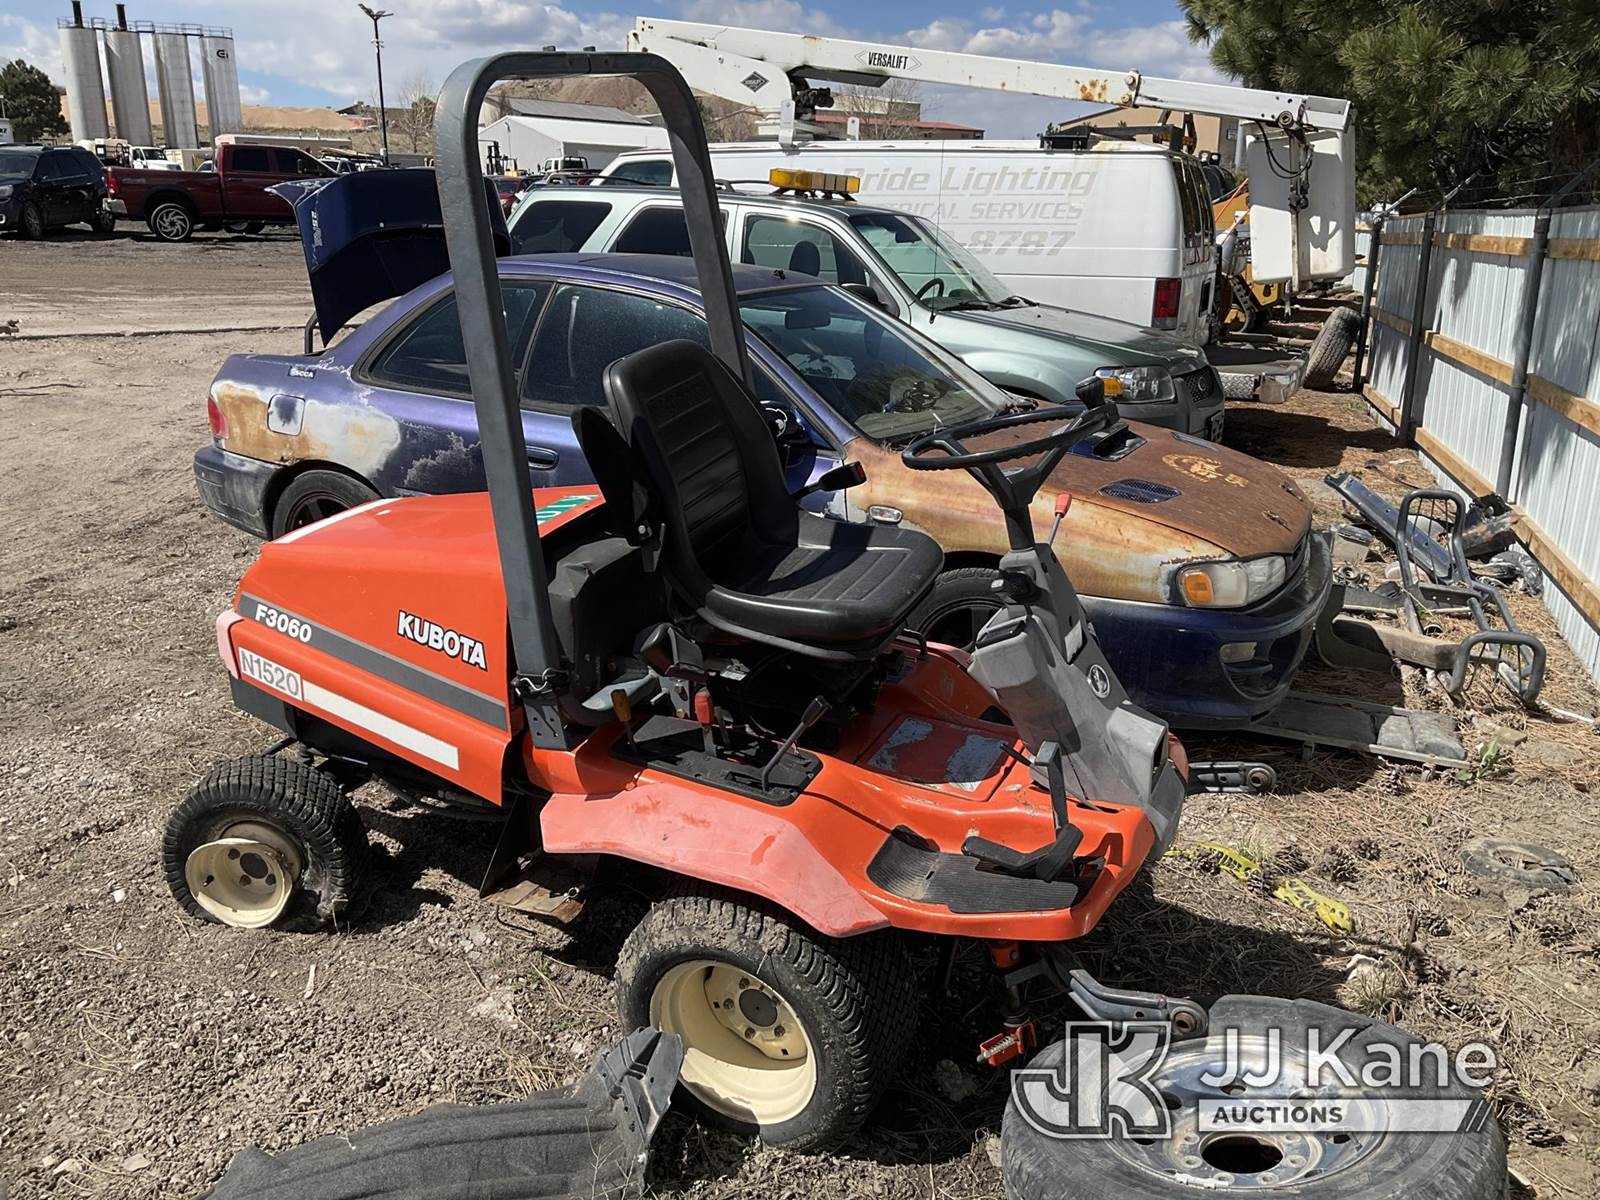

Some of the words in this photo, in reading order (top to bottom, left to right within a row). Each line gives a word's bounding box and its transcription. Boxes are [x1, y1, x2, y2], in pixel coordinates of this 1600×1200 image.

[868, 51, 908, 70] VERSALIFT
[942, 166, 1098, 196] Lighting
[254, 603, 312, 643] F3060
[397, 609, 488, 672] KUBOTA
[240, 651, 299, 696] N1520
